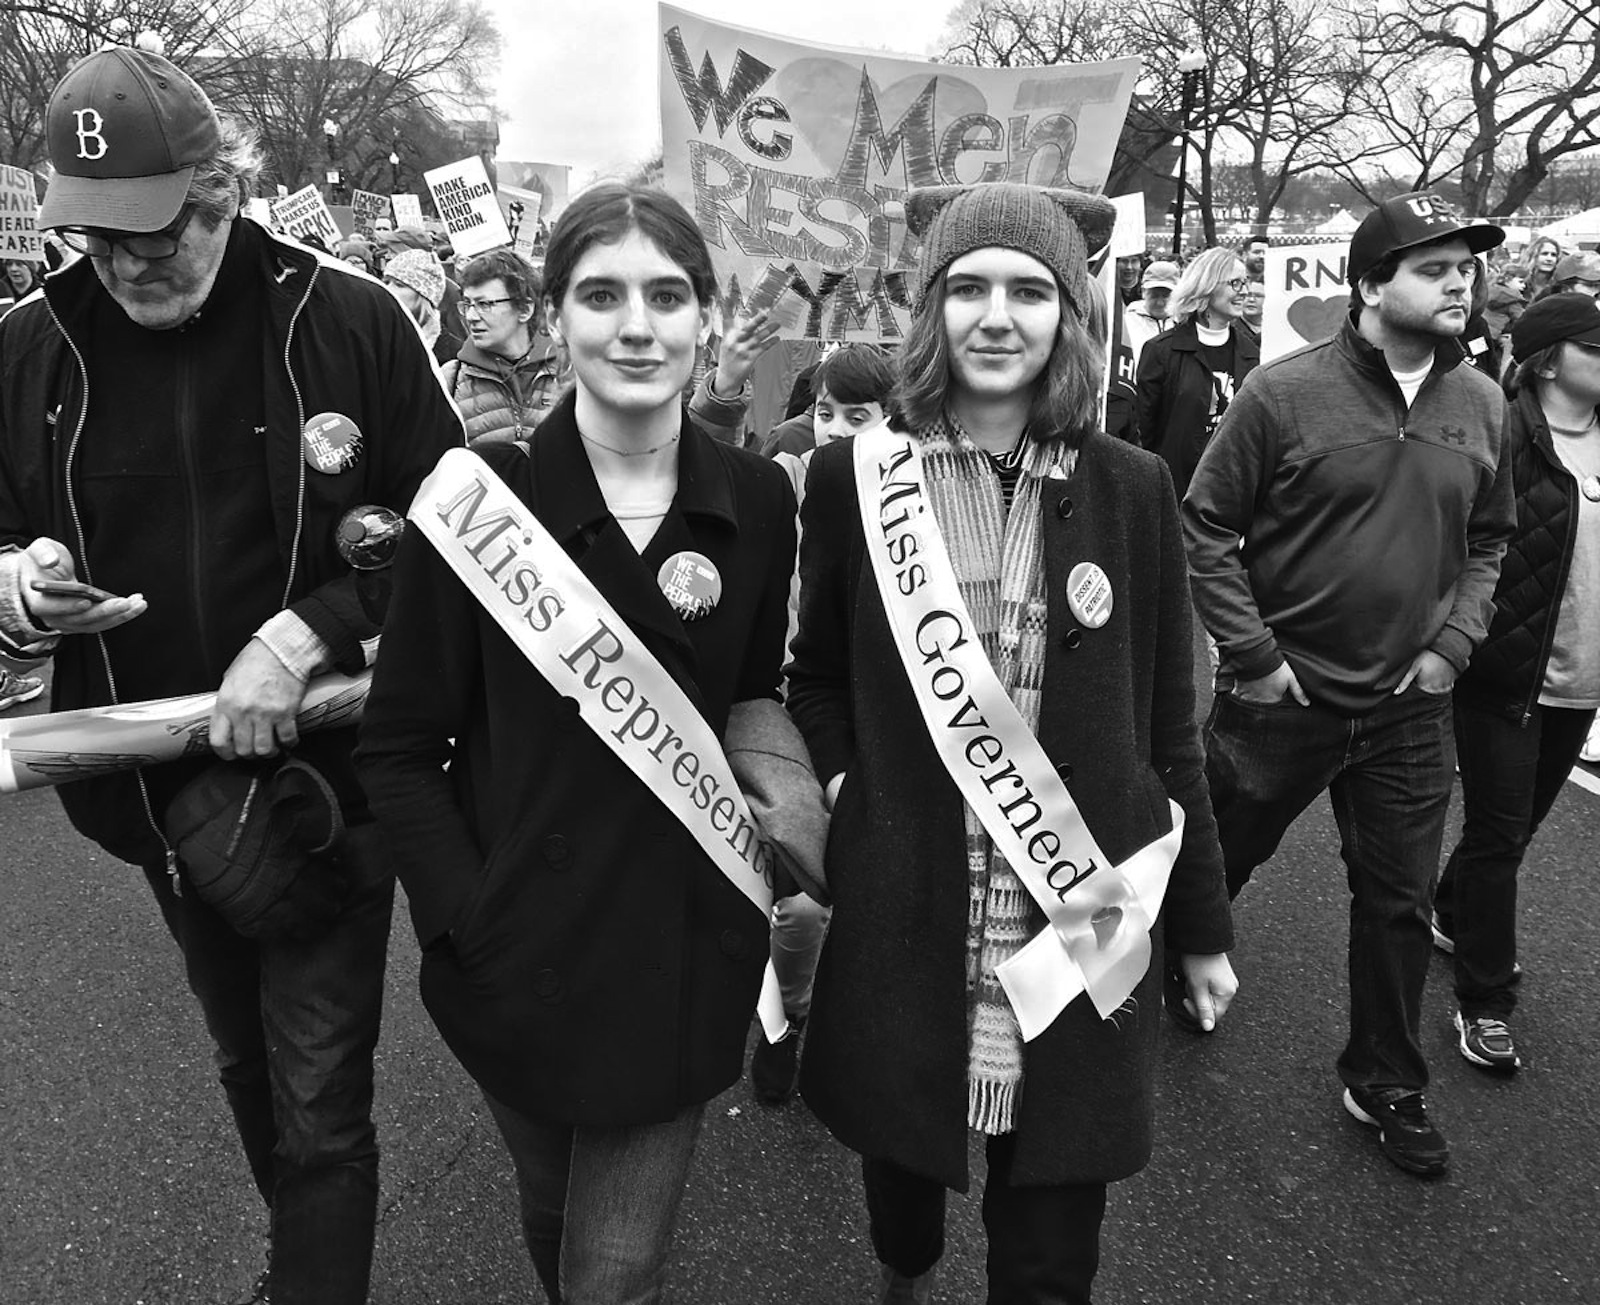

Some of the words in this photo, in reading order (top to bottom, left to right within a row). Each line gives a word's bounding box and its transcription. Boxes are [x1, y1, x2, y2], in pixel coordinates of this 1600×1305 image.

[664, 25, 793, 161] We
[72, 108, 109, 160] B
[0, 166, 33, 191] UST
[433, 176, 467, 198] MAKE
[438, 182, 491, 210] AMERICA
[687, 140, 915, 269] RESI
[281, 205, 309, 224] MAKES
[308, 199, 321, 210] US
[442, 202, 472, 222] KIND
[447, 211, 488, 234] AGAIN.
[289, 210, 335, 240] SICK!
[303, 427, 325, 444] WE
[310, 438, 334, 457] THE
[436, 473, 566, 632] Miss
[677, 556, 695, 576] WE
[671, 568, 692, 591] THE
[878, 441, 928, 597] Miss
[915, 609, 1099, 904] Governed
